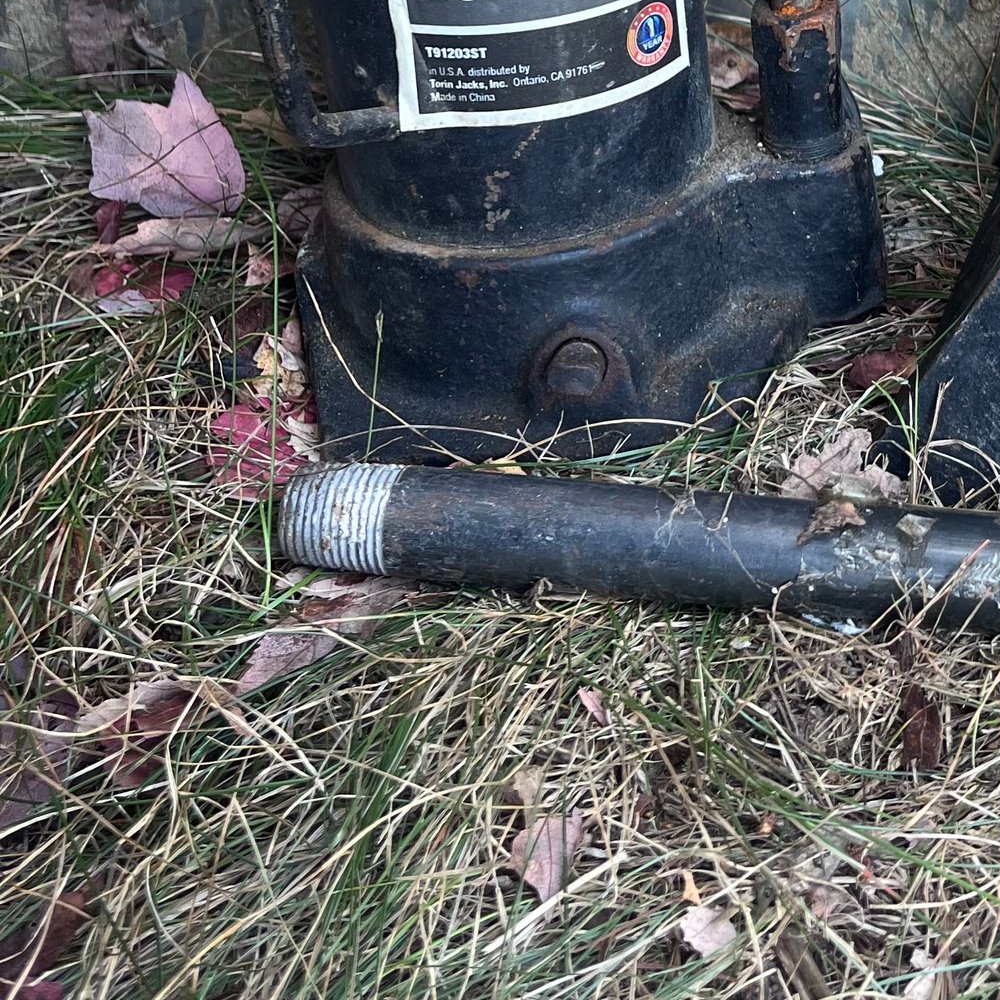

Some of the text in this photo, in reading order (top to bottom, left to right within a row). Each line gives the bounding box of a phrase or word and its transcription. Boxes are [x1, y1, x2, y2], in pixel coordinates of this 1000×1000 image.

[642, 35, 663, 51] YEAR
[424, 46, 488, 59] T91203ST
[467, 64, 517, 77] distributed
[518, 64, 530, 75] by
[429, 78, 454, 89] Torin
[455, 79, 488, 90] Jacks,
[489, 79, 509, 89] Inc.
[513, 74, 549, 87] Ontario,
[550, 71, 565, 81] CA
[430, 92, 496, 102] Made in China
